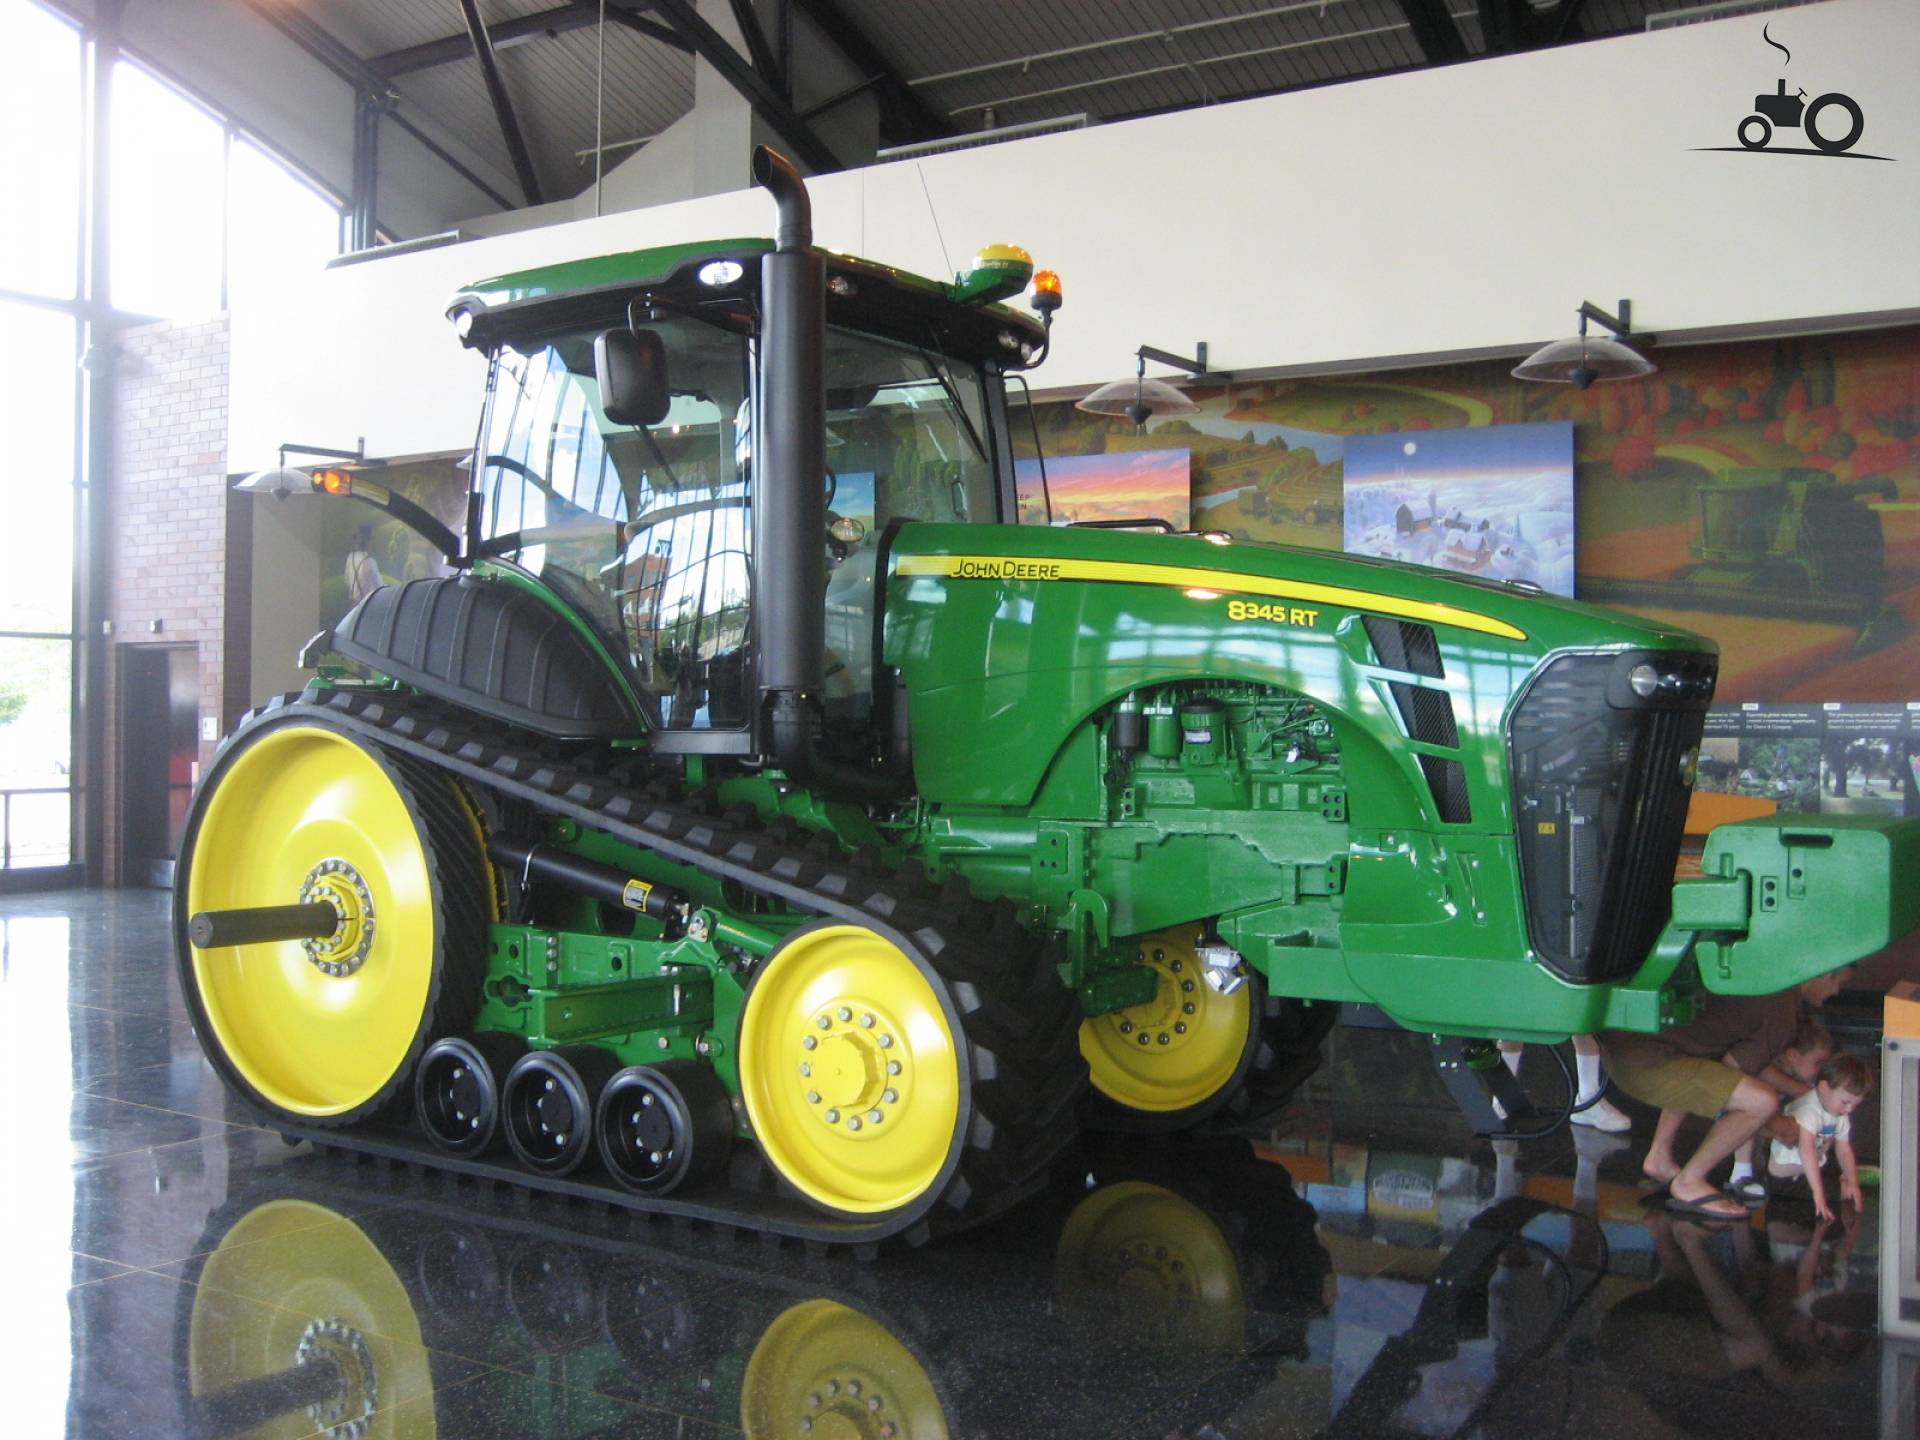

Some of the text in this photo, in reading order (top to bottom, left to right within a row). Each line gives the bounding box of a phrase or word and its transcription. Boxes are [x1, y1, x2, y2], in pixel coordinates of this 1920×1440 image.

[953, 559, 1060, 577] JOHN DEERE
[1228, 600, 1318, 627] 8345 RT
